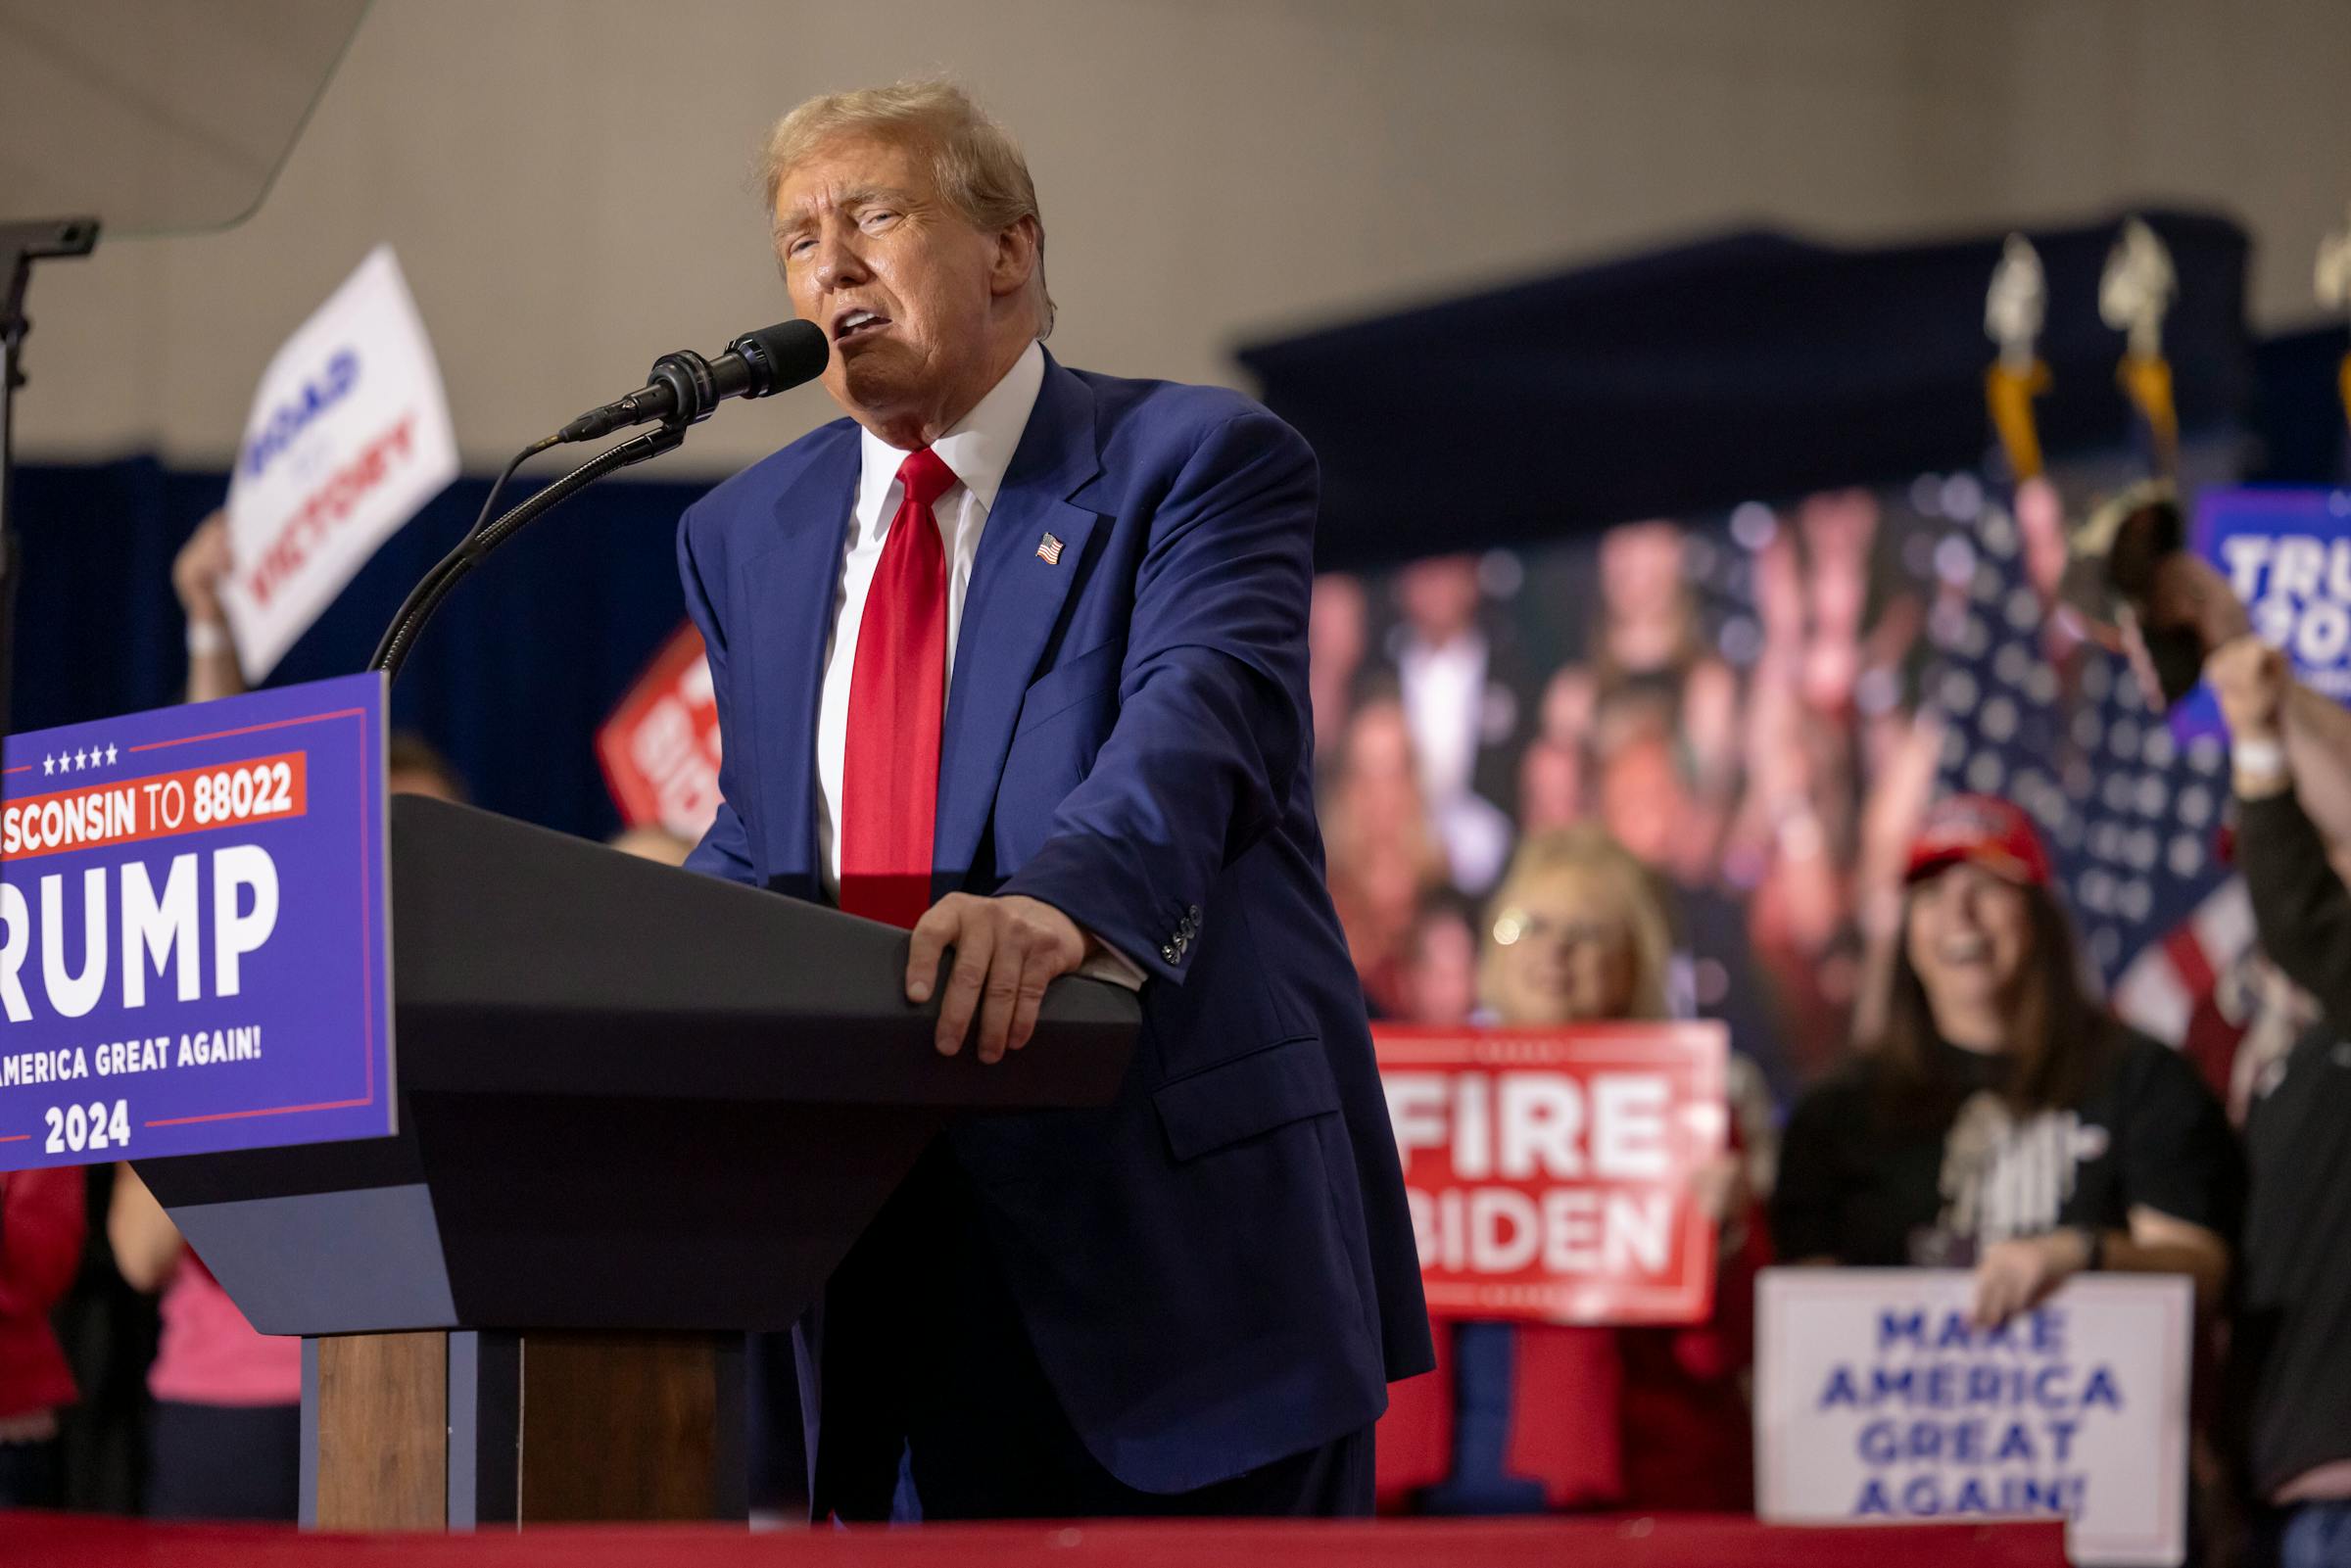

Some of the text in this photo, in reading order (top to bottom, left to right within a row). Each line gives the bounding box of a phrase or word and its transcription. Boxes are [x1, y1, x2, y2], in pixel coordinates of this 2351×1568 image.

[251, 409, 417, 611] VICTORY
[0, 761, 292, 854] SCONSIN TO 88022
[0, 1025, 263, 1087] MERICA GREAT AGAIN!
[45, 1099, 130, 1155] 2024
[1379, 1069, 1669, 1178] FIRE
[1819, 1363, 2123, 1410] AMERICA
[1856, 1419, 2078, 1465] GREAT
[1854, 1475, 2086, 1521] AGAIN!
